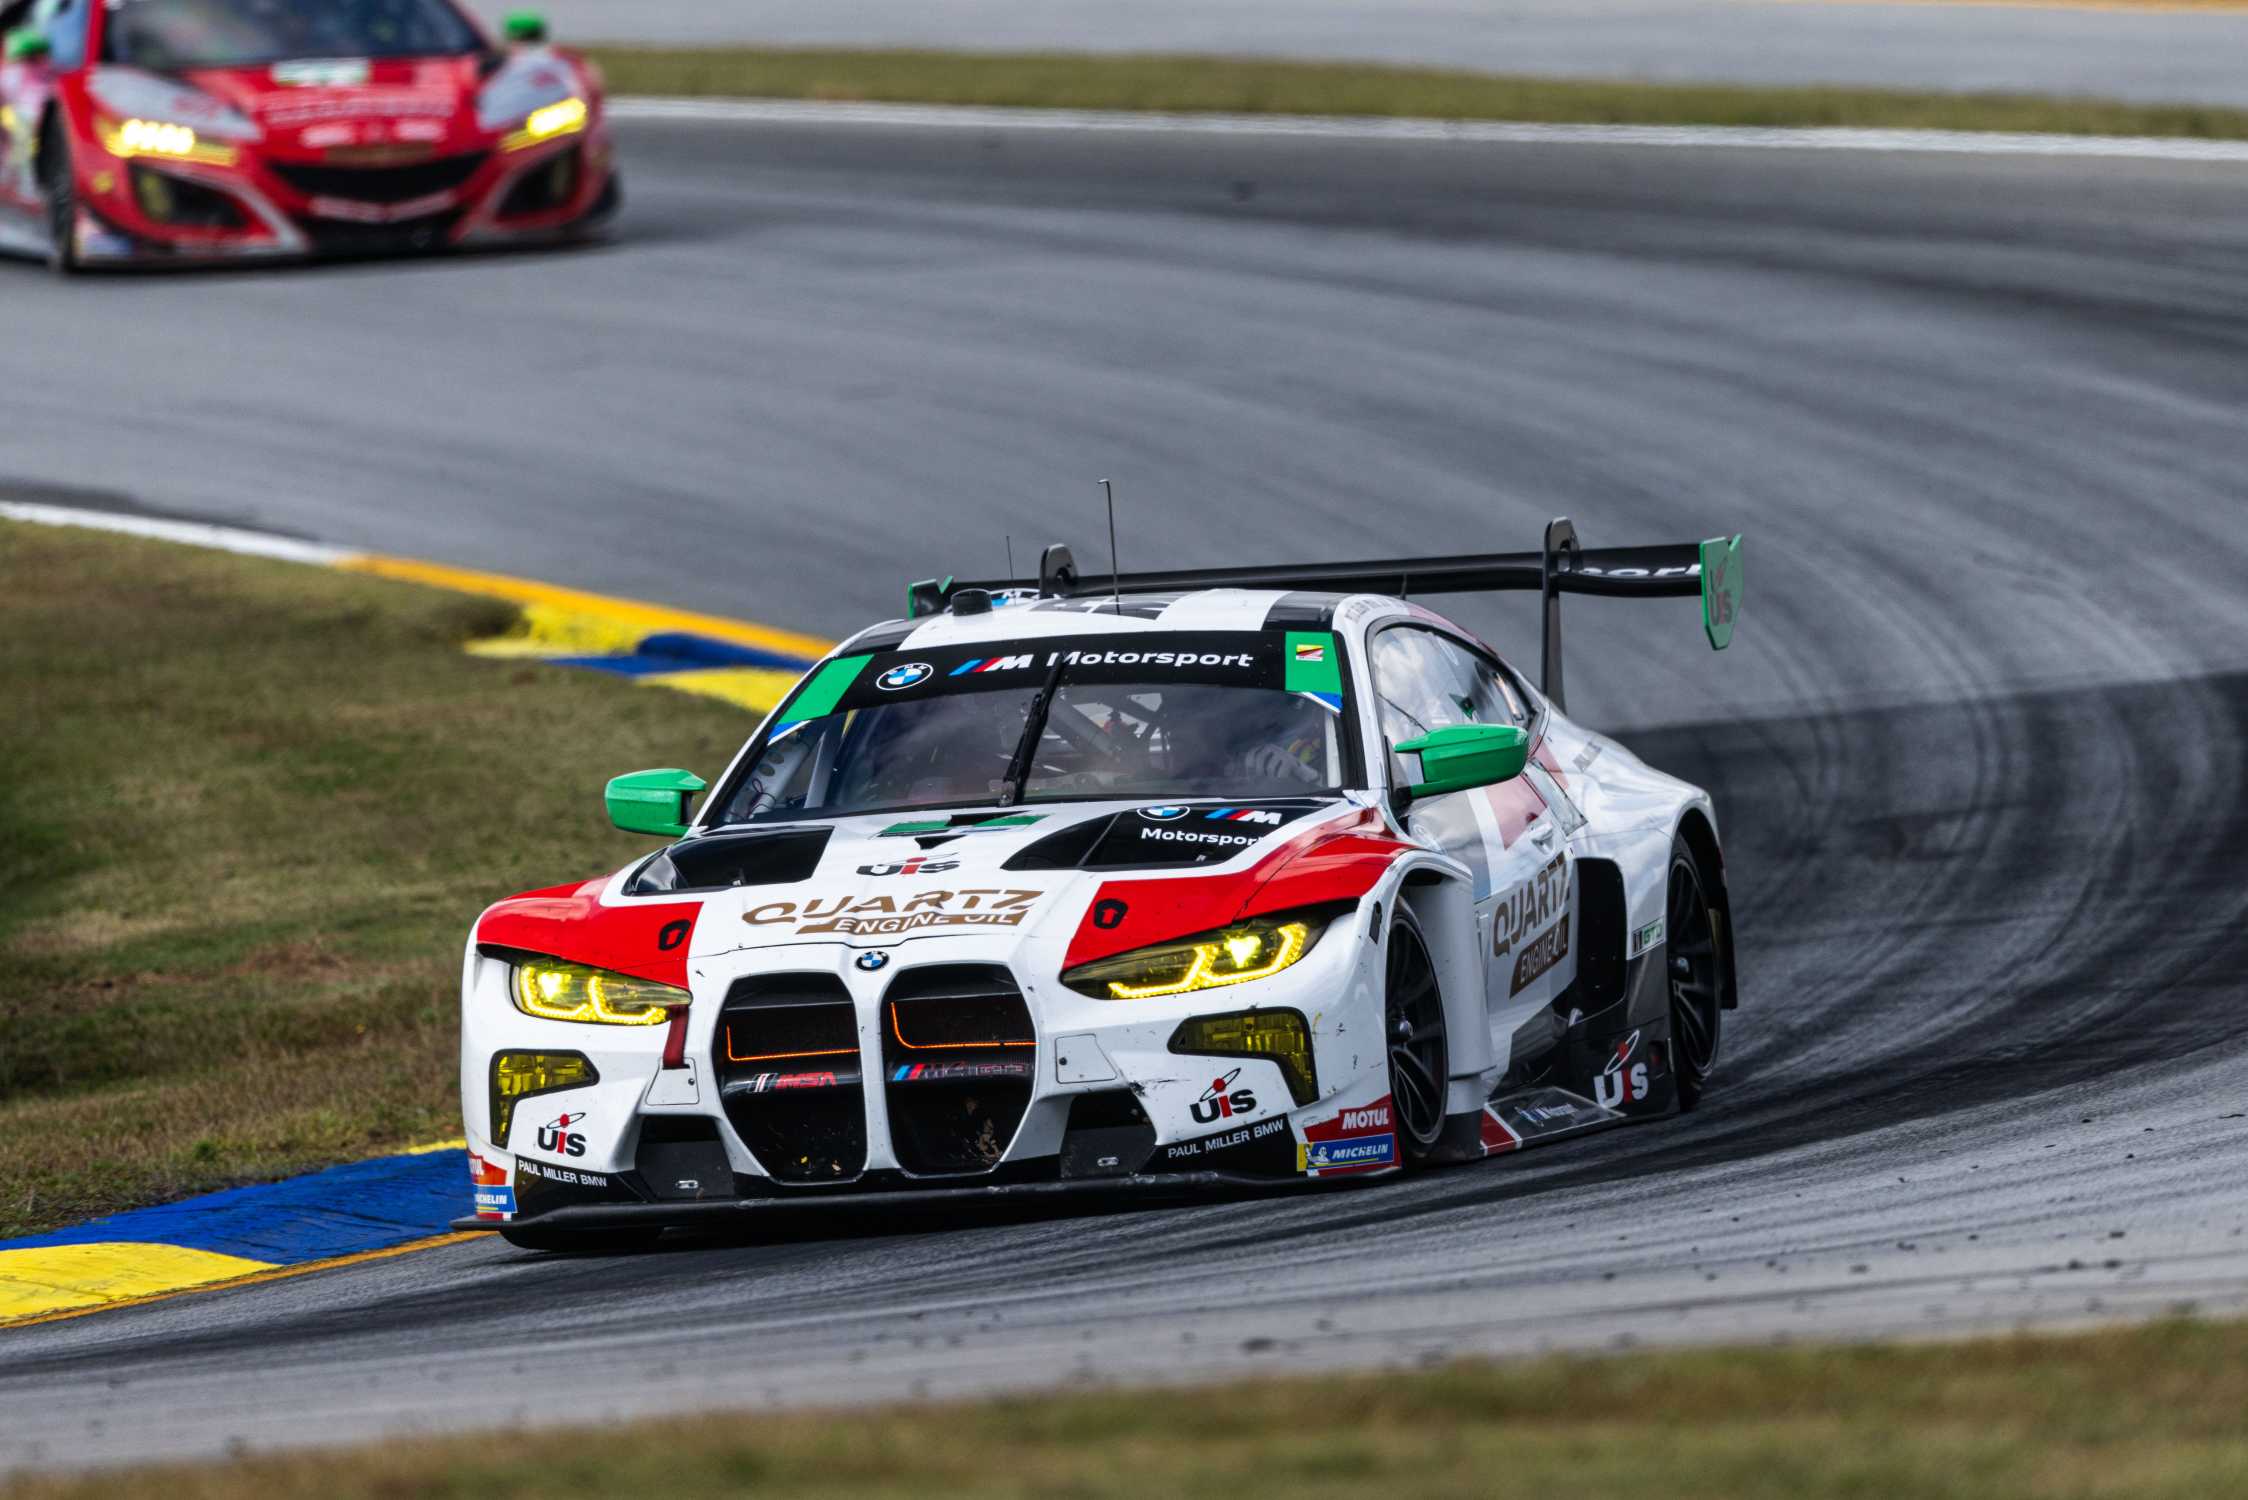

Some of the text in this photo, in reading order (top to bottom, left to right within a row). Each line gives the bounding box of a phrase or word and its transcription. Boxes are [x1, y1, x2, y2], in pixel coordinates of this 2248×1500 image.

[1046, 650, 1253, 667] Motorsport
[741, 889, 1044, 925] QUARTZ
[1493, 850, 1570, 957] QUARTZ
[833, 911, 950, 933] ENGINE
[1342, 1107, 1390, 1130] MOTUL
[1168, 1118, 1285, 1159] PAUL MILLER BMW
[1332, 1143, 1389, 1160] MICHELIN
[518, 1159, 607, 1188] PAUL MILLER BMW
